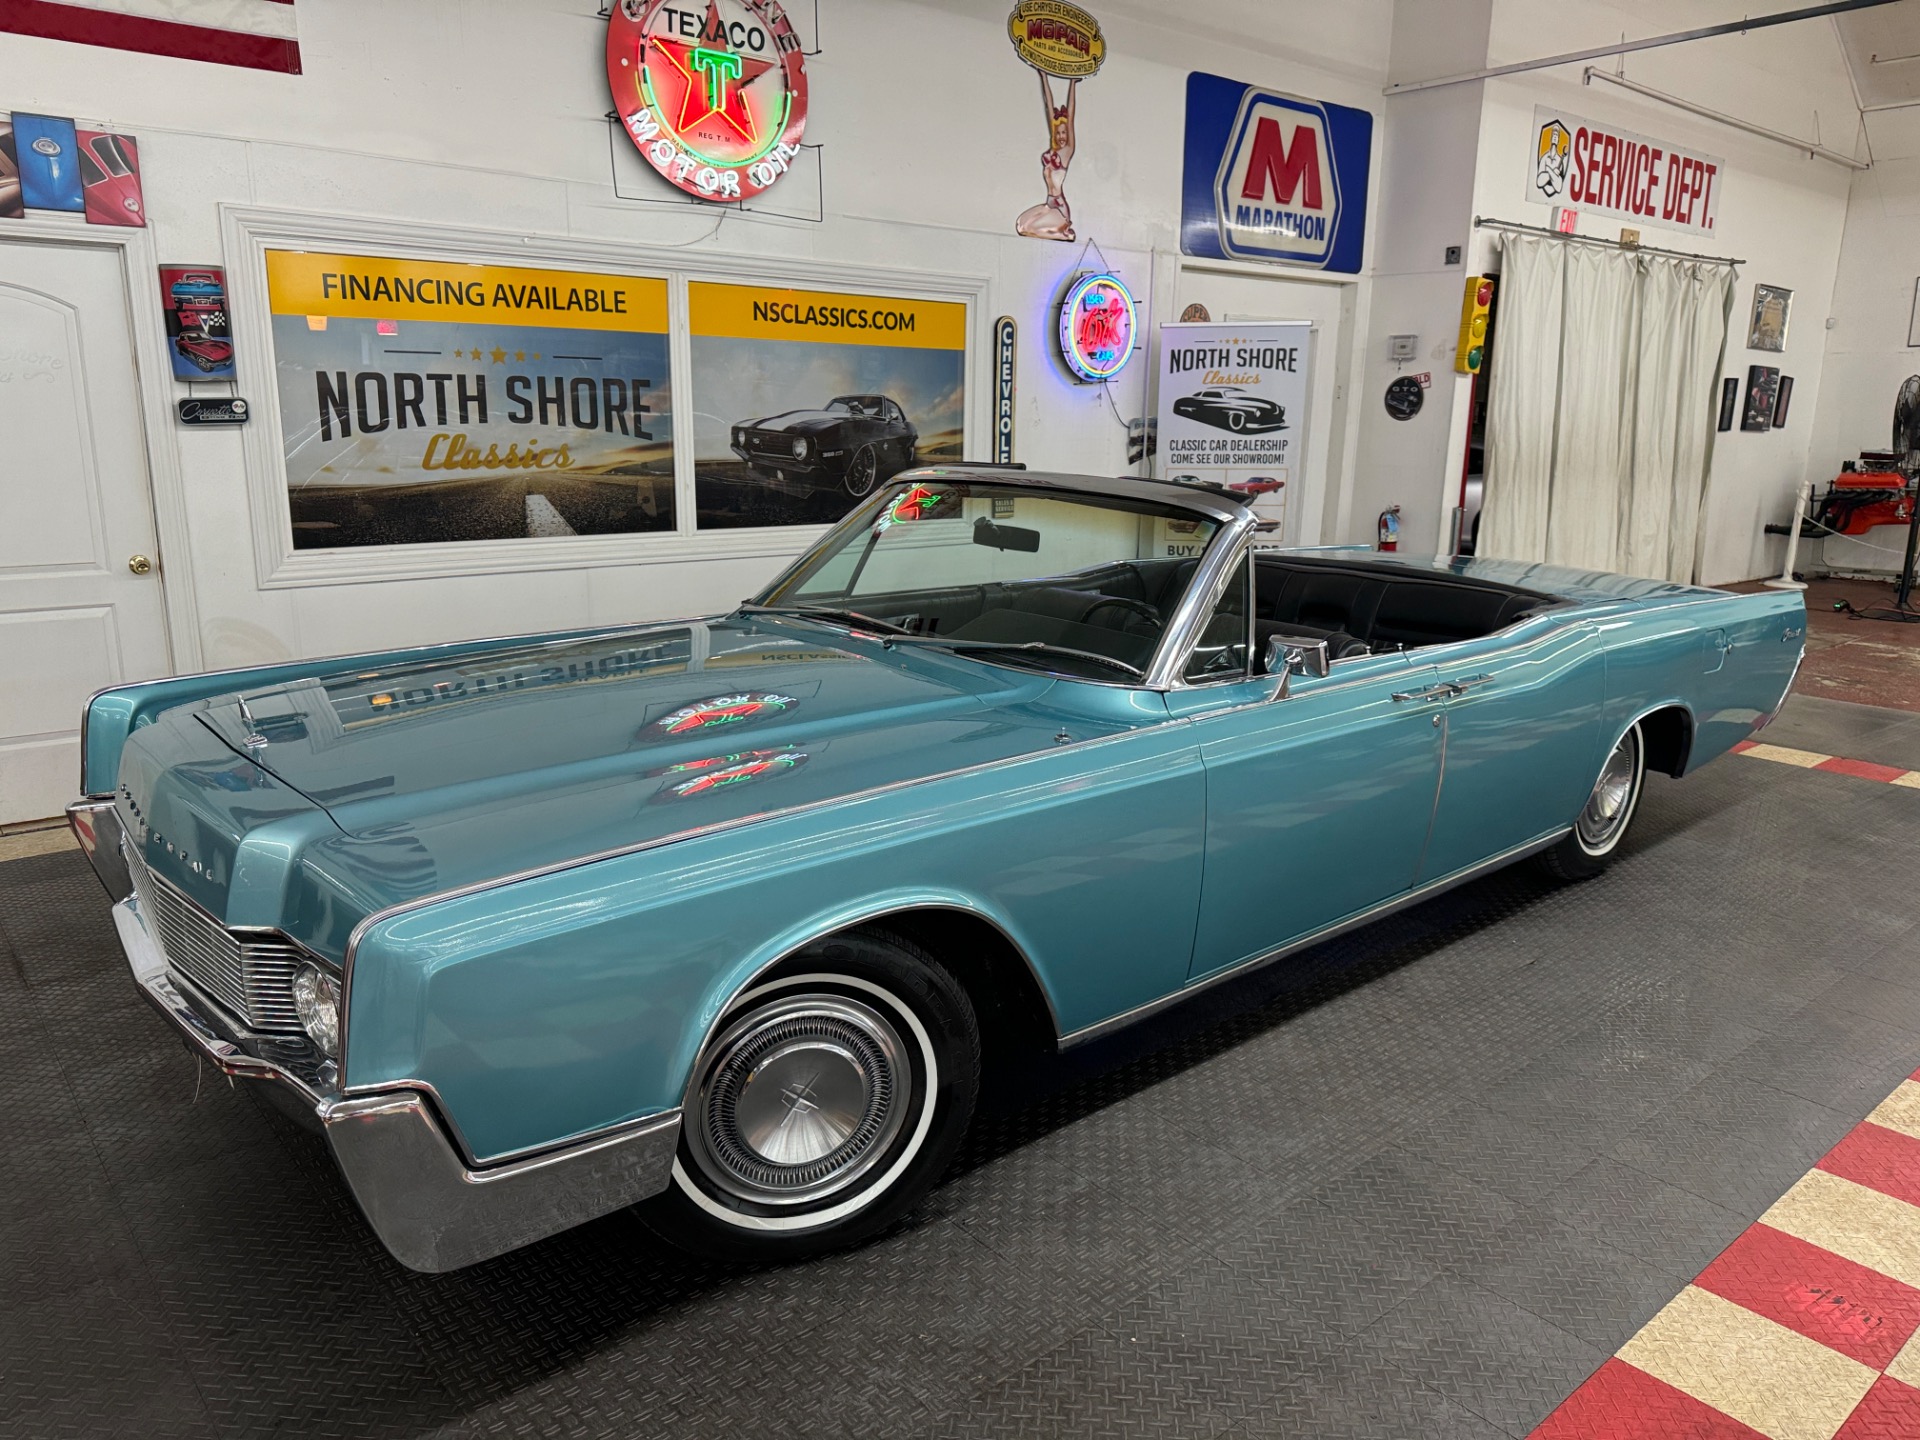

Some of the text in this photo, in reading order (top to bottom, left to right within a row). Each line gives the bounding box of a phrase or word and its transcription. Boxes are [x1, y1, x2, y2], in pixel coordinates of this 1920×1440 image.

[1021, 3, 1033, 13] USE
[1033, 2, 1062, 16] CHRYSLER
[661, 7, 766, 52] TEXACO
[1033, 41, 1047, 51] PARTS
[626, 108, 801, 198] MOTOR OIL
[1569, 126, 1717, 229] SERVICE DEPT.
[1236, 204, 1326, 242] MARATHON
[1559, 209, 1577, 233] EXIT
[322, 272, 627, 314] FINANCING AVAILABLE
[752, 300, 915, 332] NSCLASSICS.COM
[1169, 347, 1298, 374] NORTH SHORE
[1202, 370, 1262, 385] Classics
[315, 370, 654, 442] NORTH SHORE
[1000, 326, 1013, 464] CHEVROLE
[421, 432, 576, 472] Classics
[1169, 439, 1289, 452] CLASSIC CAR DEALERSHIP
[1170, 453, 1285, 465] COME SEE OUR SHOWROOM!
